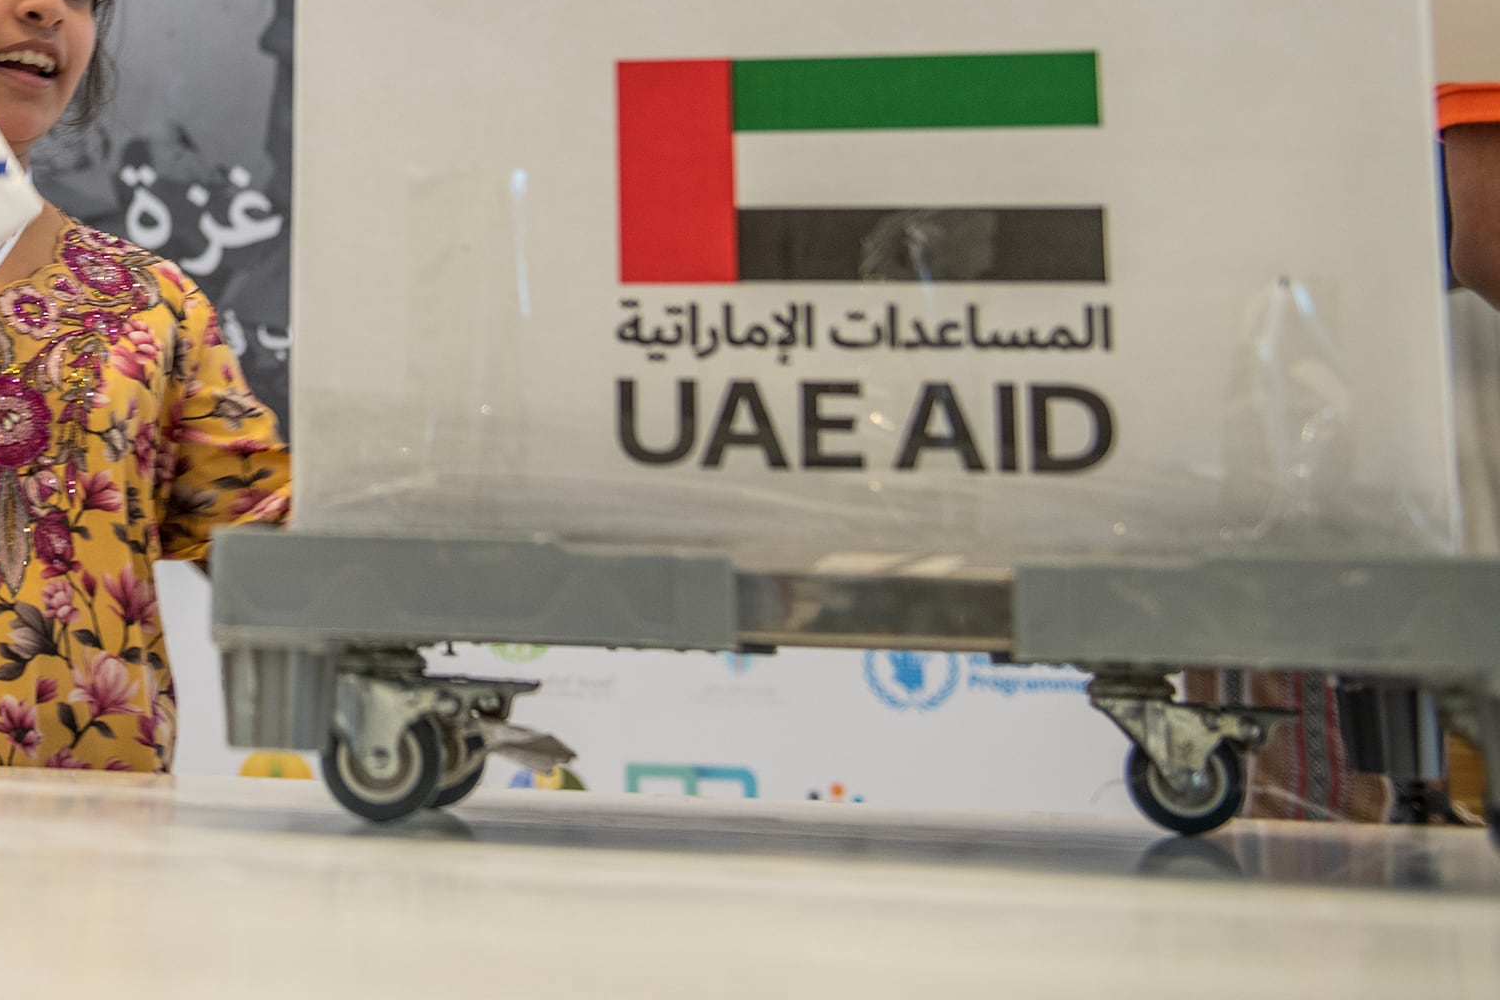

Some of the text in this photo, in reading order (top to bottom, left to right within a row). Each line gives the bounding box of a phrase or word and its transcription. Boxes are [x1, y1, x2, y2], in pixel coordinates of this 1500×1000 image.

[120, 165, 284, 276] غزة
[614, 298, 1113, 366] المساعدات الإماراتية
[615, 377, 1116, 475] UAE AID
